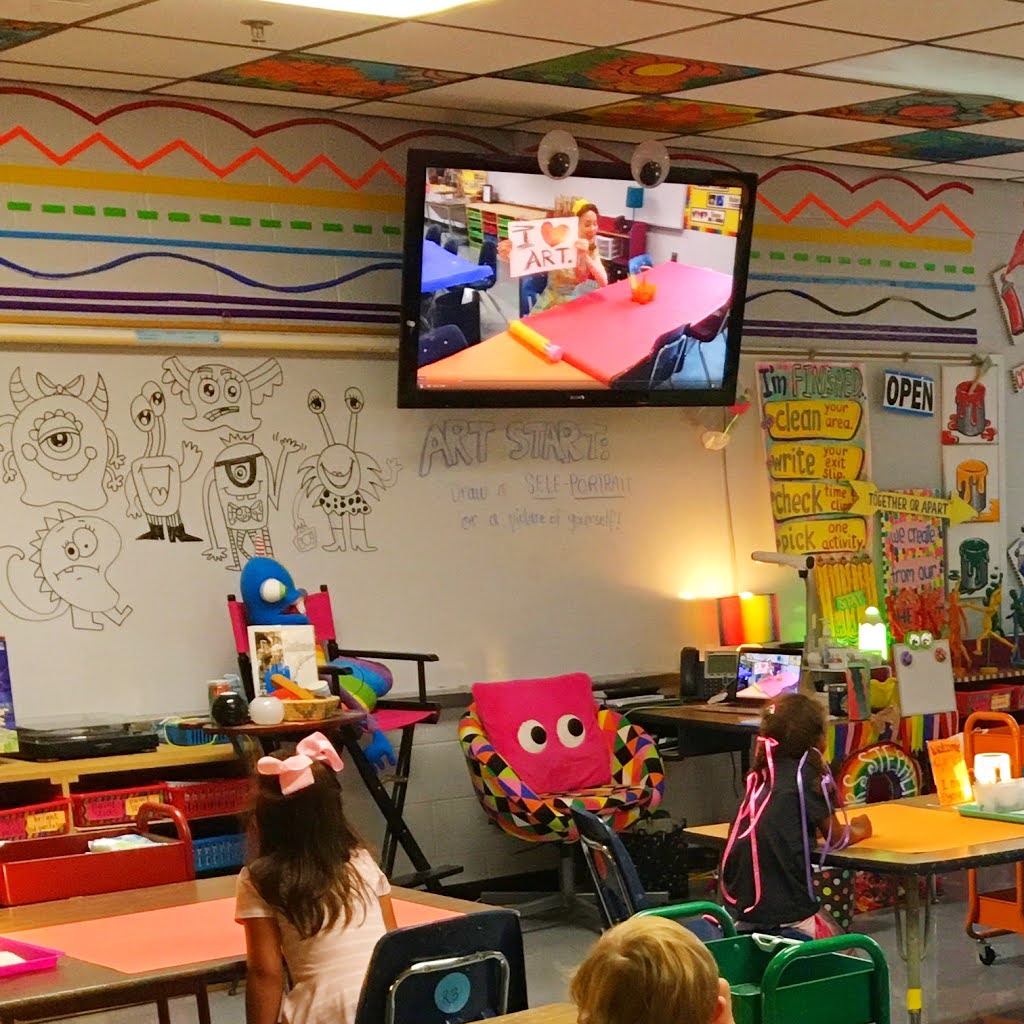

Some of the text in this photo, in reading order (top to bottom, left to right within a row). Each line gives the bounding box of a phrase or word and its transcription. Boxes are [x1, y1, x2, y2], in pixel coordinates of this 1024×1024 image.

[512, 225, 535, 248] I
[525, 247, 573, 270] ART.
[758, 365, 787, 398] I'm
[886, 375, 934, 412] OPEN
[775, 402, 821, 432] clean
[824, 403, 849, 415] your
[825, 417, 853, 430] area.
[418, 419, 611, 478] ART START:
[823, 447, 848, 458] your
[771, 446, 816, 475] write
[825, 458, 846, 469] exit
[775, 484, 823, 515] check
[824, 484, 847, 498] time
[869, 493, 948, 515] TOGETHER OR APART
[780, 523, 816, 553] pick
[828, 522, 848, 534] one
[890, 524, 936, 545] we create
[821, 534, 866, 553] activity.
[891, 564, 937, 584] from our
